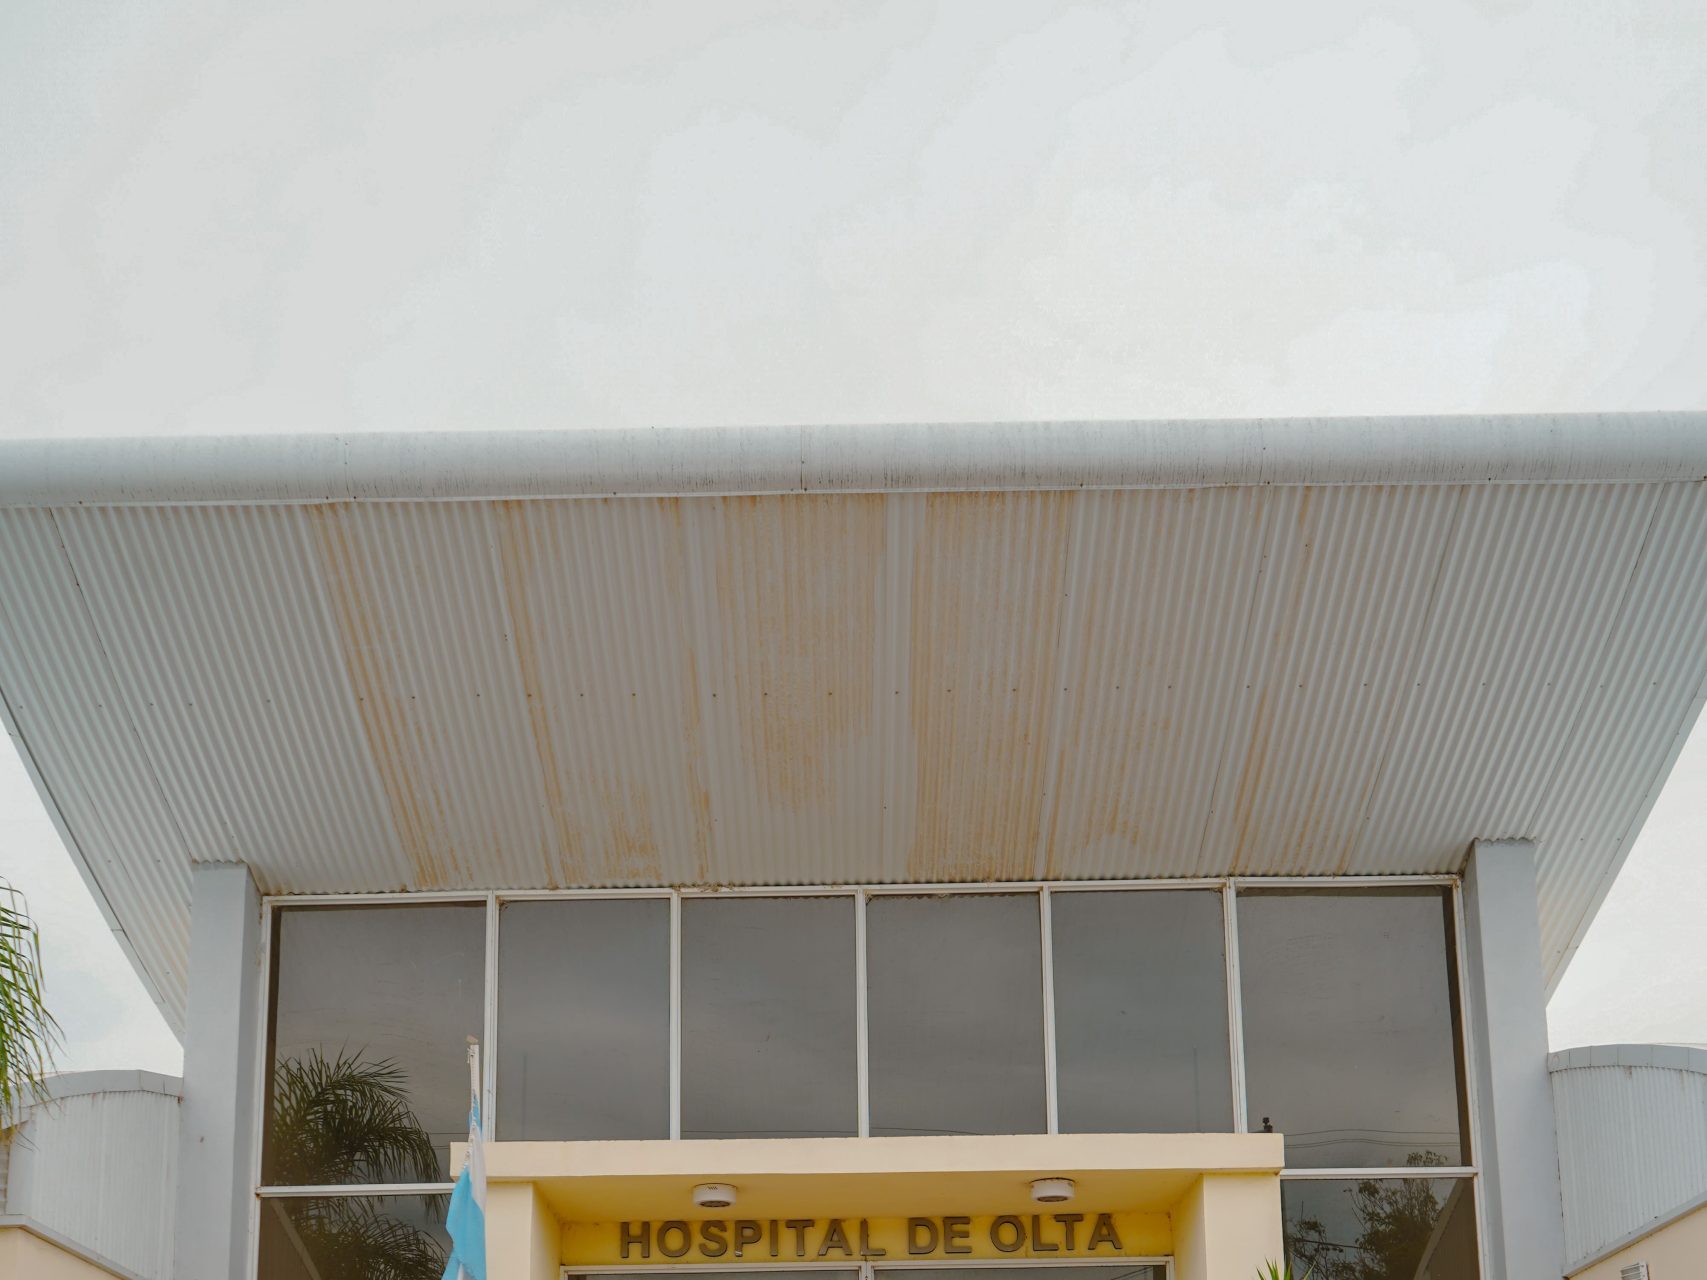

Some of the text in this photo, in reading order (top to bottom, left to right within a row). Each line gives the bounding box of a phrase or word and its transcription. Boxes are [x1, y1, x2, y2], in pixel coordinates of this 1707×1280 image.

[620, 1213, 1122, 1258] HOSPITAL DE OLTA
